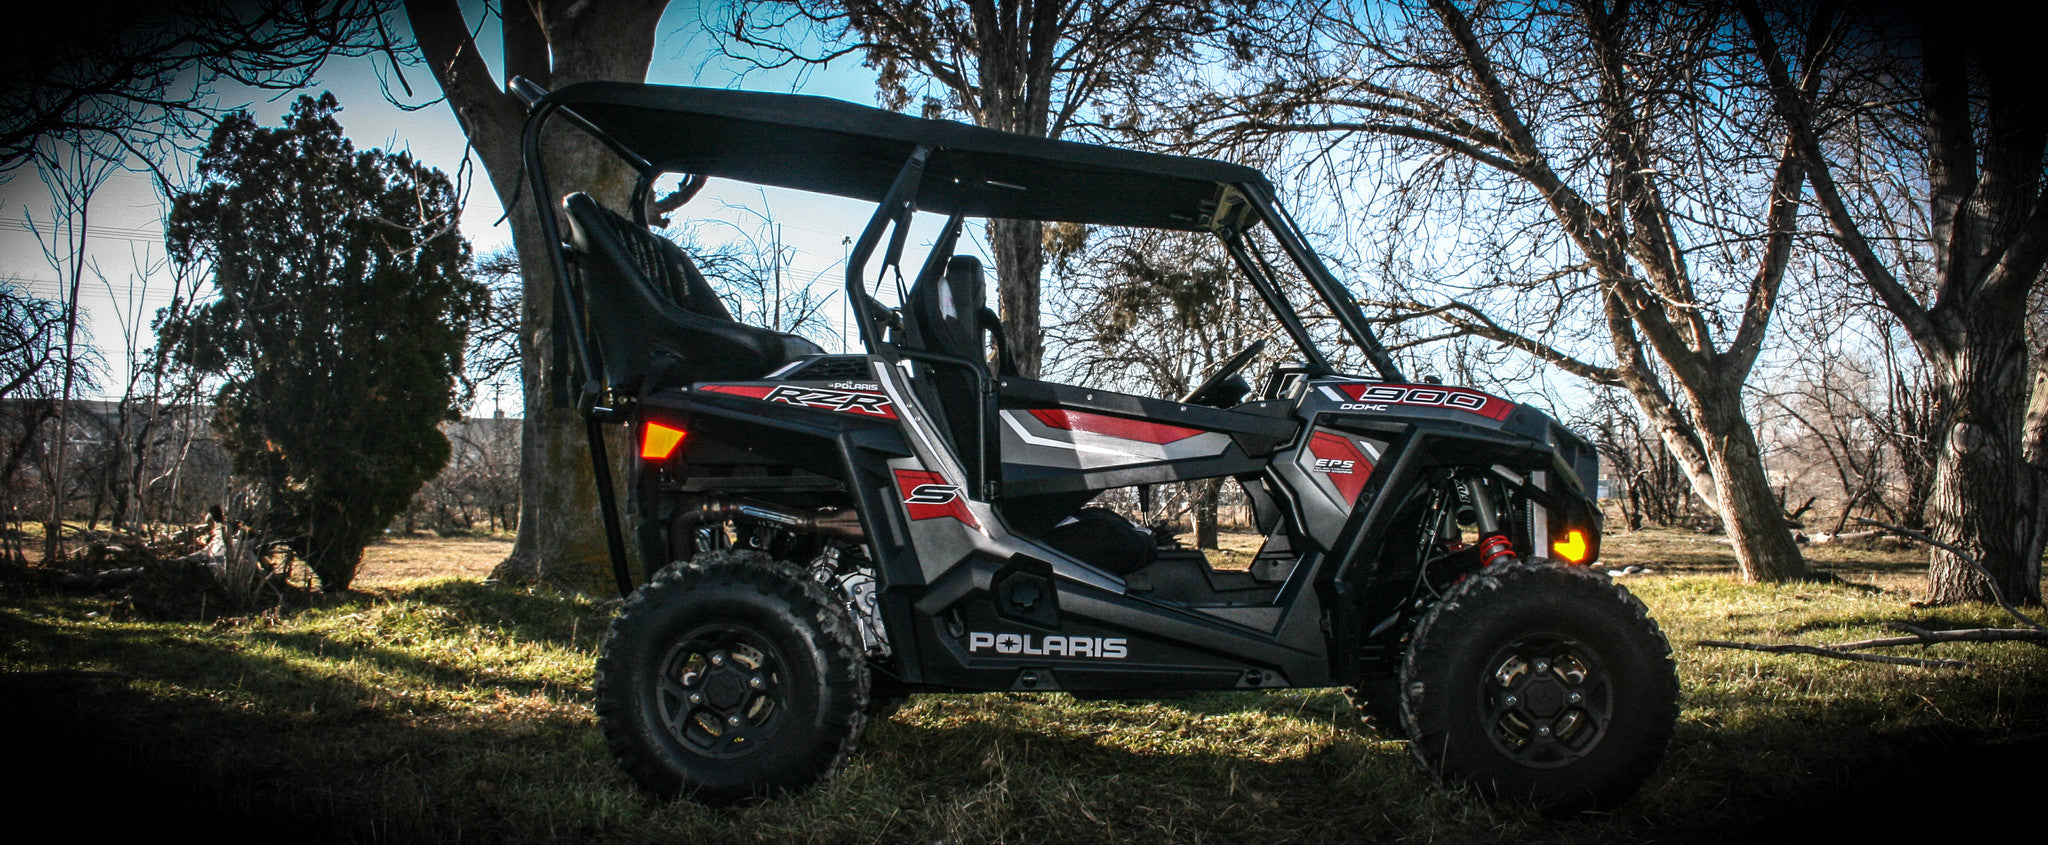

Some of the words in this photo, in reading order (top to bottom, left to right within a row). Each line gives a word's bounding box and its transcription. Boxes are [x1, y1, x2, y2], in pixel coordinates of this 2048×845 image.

[834, 382, 879, 391] POLARIS
[763, 385, 892, 415] RZR
[1340, 403, 1389, 411] DOHC
[1359, 386, 1487, 411] 900
[1315, 458, 1355, 468] EPS
[903, 484, 963, 504] S
[970, 632, 1127, 659] POLARIS
